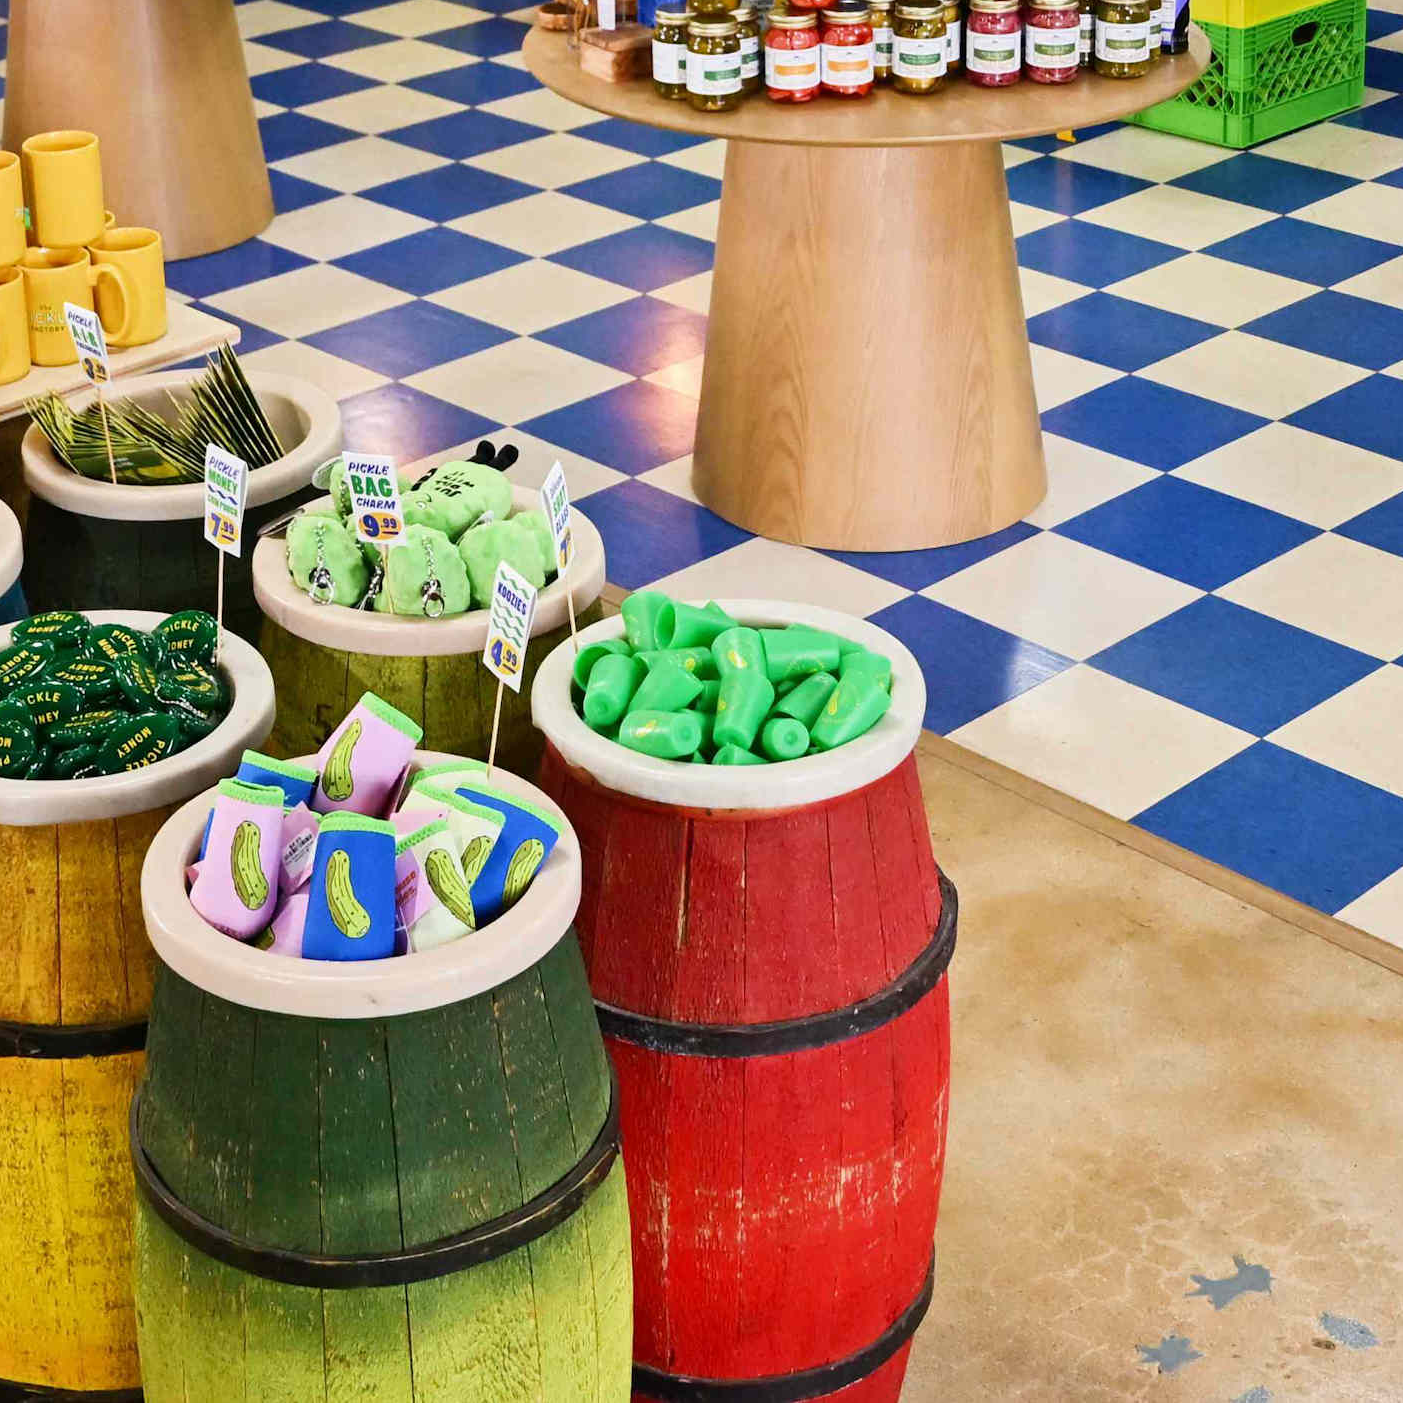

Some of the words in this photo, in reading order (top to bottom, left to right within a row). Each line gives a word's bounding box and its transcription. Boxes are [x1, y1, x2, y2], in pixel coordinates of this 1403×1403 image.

[208, 455, 241, 480] PICKLE
[348, 461, 389, 476] PICKLE
[207, 468, 239, 496] MONEY
[350, 474, 394, 497] BAG
[355, 496, 396, 510] CHARM
[362, 514, 399, 538] 9.99
[496, 580, 527, 616] KOOZIES
[27, 624, 63, 634] MONEY
[33, 613, 74, 625] PICKLE
[163, 620, 201, 636] PICKLE
[491, 638, 518, 668] 4.99
[2, 654, 41, 684] PICKLE
[54, 670, 98, 682] PICKLE
[69, 663, 107, 673] MONEY
[26, 690, 62, 706] CKLE
[116, 725, 153, 761] MONEY
[124, 738, 167, 774] PICKLE
